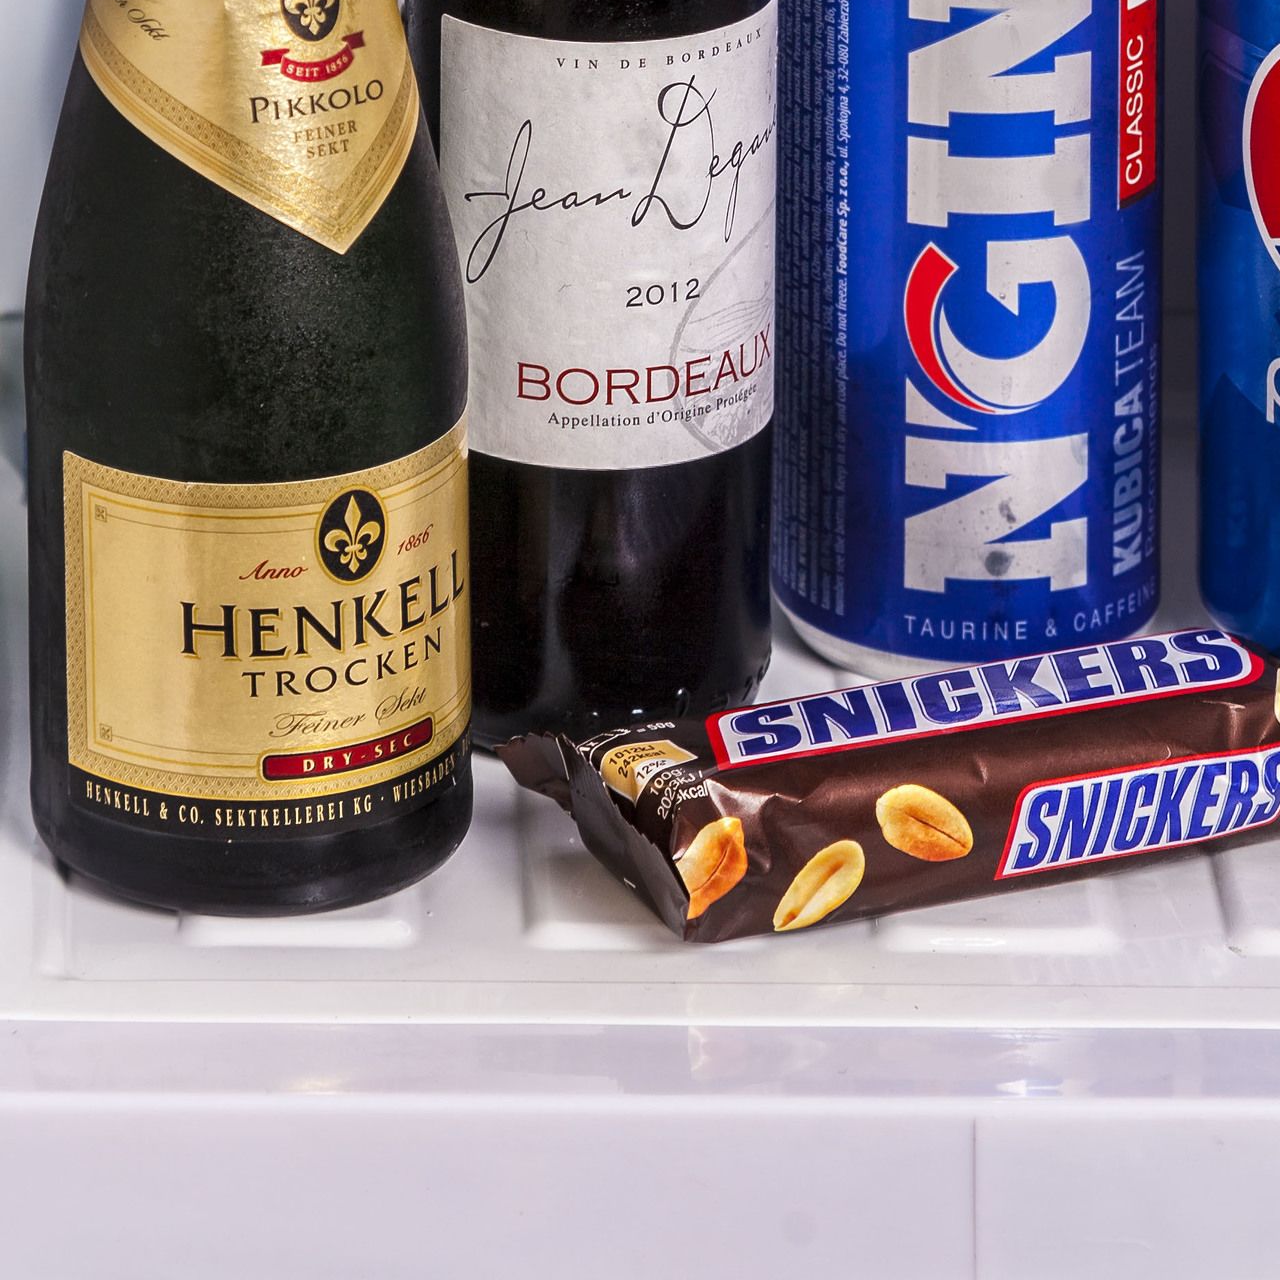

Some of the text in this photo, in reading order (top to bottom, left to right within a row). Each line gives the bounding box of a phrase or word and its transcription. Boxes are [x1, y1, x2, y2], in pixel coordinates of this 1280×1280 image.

[127, 7, 170, 42] Sekt
[556, 28, 762, 70] VIN DE BORDEAUX
[285, 53, 350, 79] SEIT 1856
[249, 79, 384, 124] PIKKOLO
[1125, 34, 1145, 185] CLASSIC
[294, 120, 359, 143] FEINER
[306, 138, 352, 160] SEKT
[465, 119, 632, 284] Jean
[626, 278, 701, 310] 2012
[516, 322, 772, 407] BORDEAUX
[547, 383, 759, 429] Appellation d'Origine Protégée
[238, 523, 435, 582] Anno 1856
[179, 549, 466, 660] HENKELL
[904, 614, 1028, 641] TAURINE
[1044, 618, 1059, 637] &
[241, 626, 443, 699] TROCKEN
[268, 687, 429, 739] Feiner Sekt
[729, 628, 1246, 758] SNICKERS
[86, 759, 457, 829] HENKELL & CO. SEKTKELLEREI KG WIESBADEN
